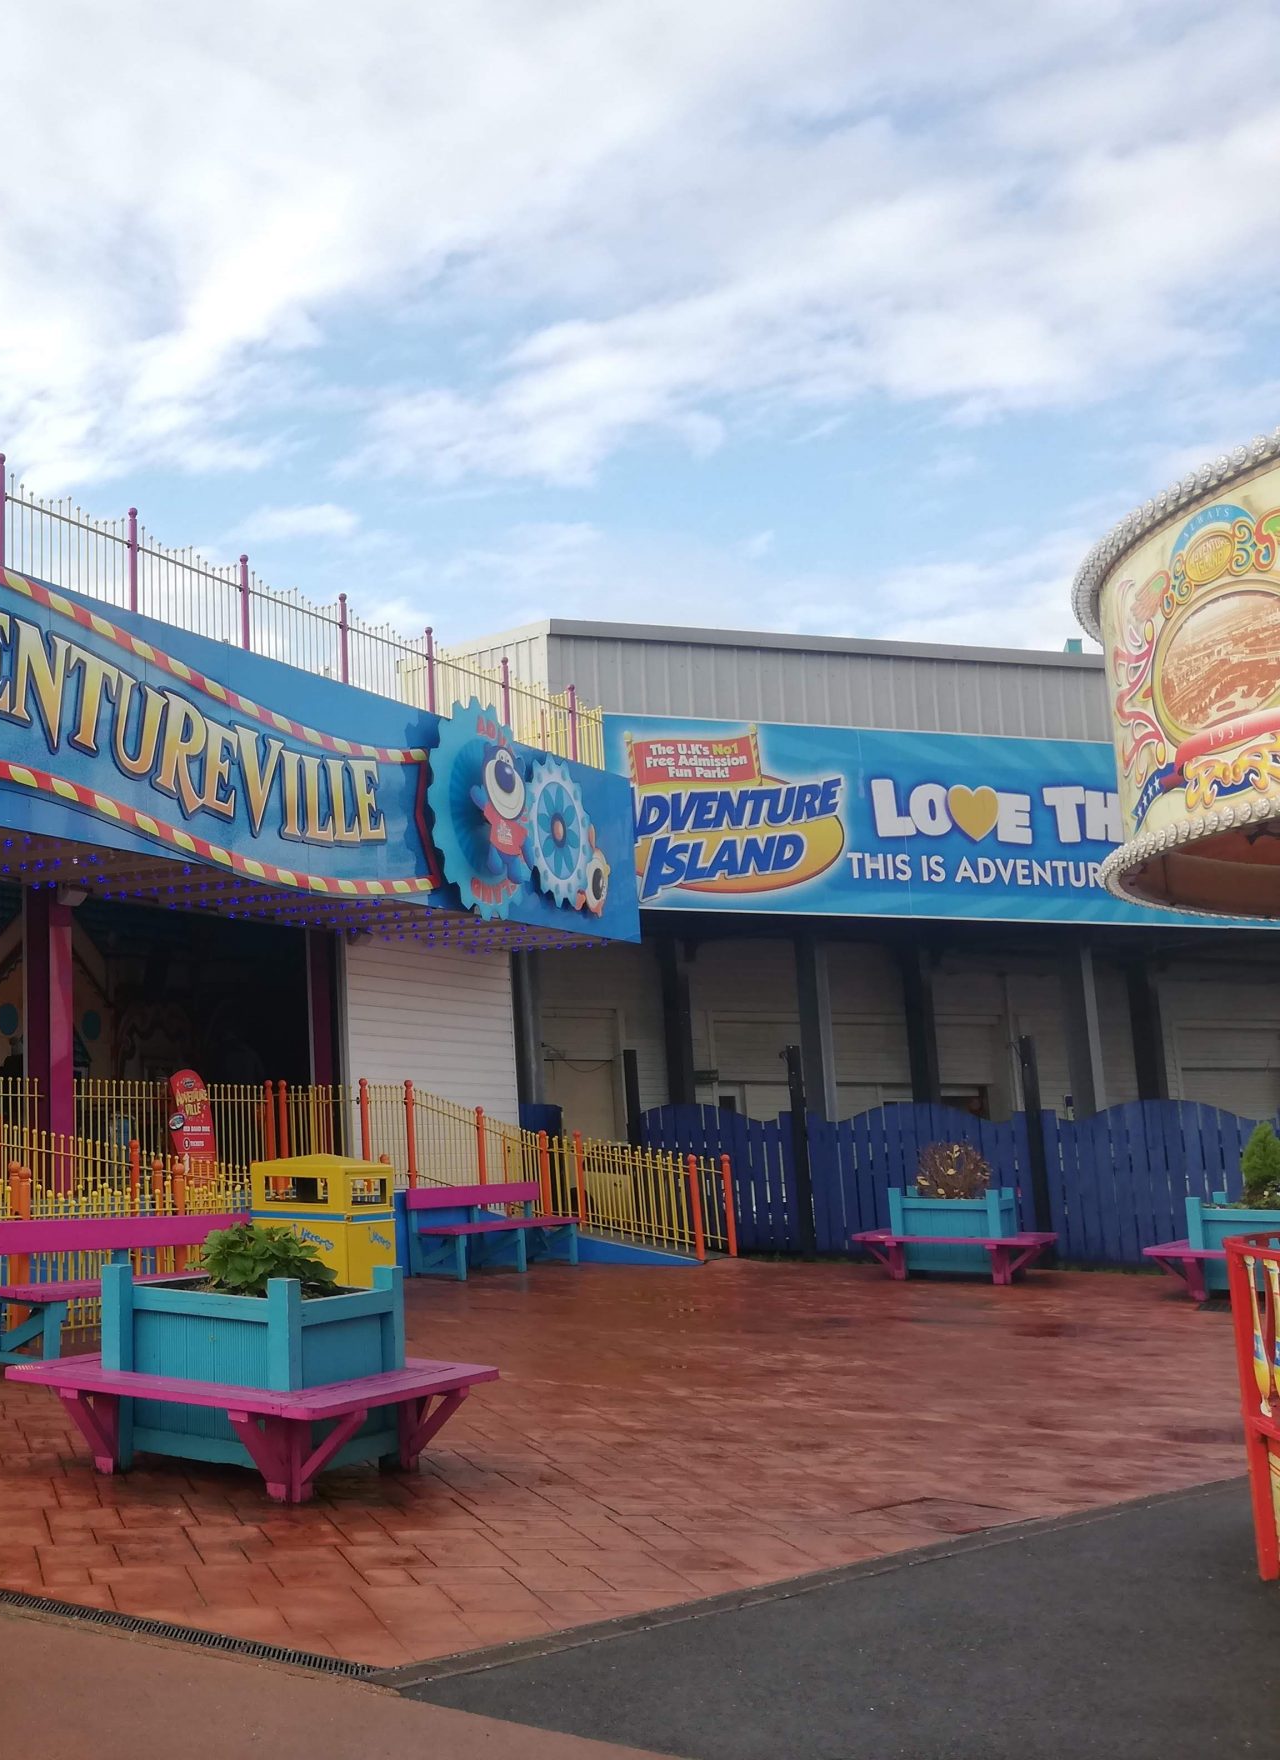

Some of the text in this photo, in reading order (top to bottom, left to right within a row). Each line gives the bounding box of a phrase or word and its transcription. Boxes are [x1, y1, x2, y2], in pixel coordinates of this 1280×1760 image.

[645, 754, 748, 768] Free Admission
[650, 743, 675, 756] The
[711, 742, 739, 756] No1
[668, 766, 730, 778] Fun Park!
[631, 776, 843, 840] DVENTURE
[1042, 785, 1124, 844] TH
[641, 832, 806, 901] ISLAND
[846, 851, 1106, 889] THIS IS ADVENTUR
[185, 1102, 201, 1116] VILLE
